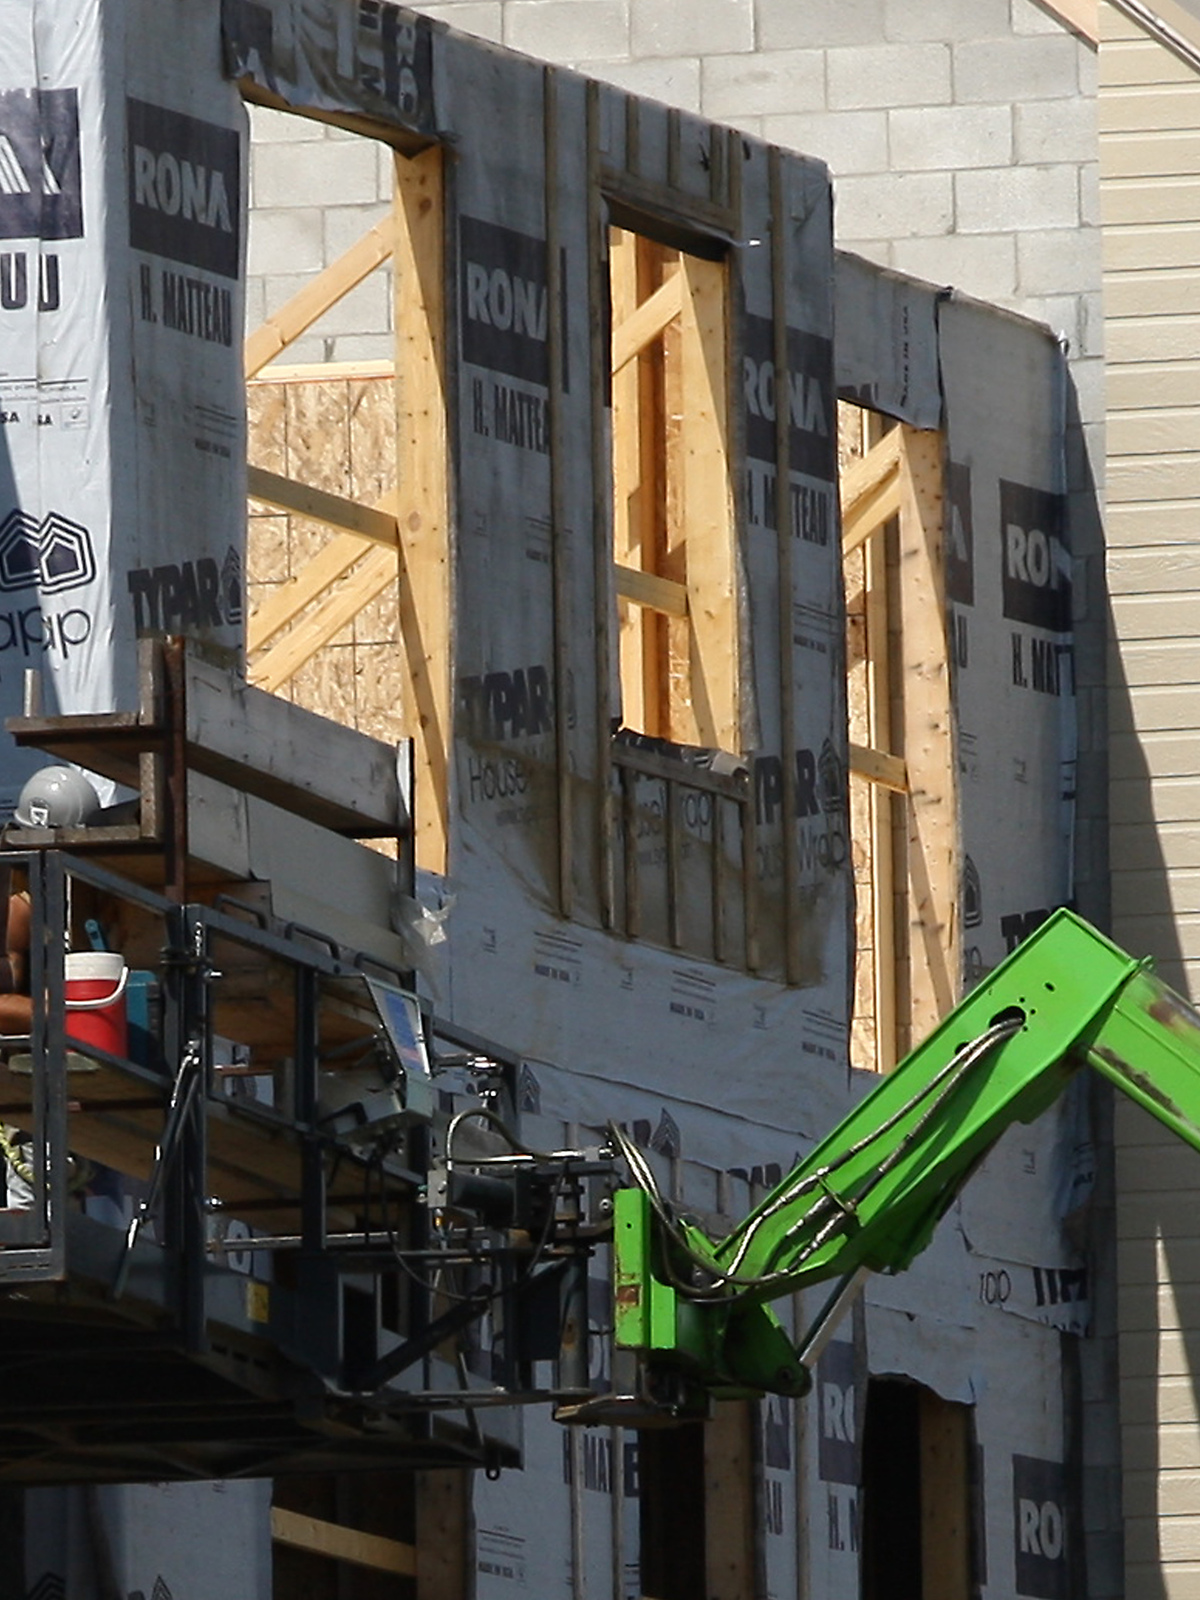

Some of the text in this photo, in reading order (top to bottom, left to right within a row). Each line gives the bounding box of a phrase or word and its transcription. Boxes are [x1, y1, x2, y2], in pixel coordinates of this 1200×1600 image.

[135, 145, 233, 233] RONA
[161, 268, 233, 349] MATTEAU
[127, 556, 225, 635] TYPAR
[1019, 1497, 1067, 1560] RO
